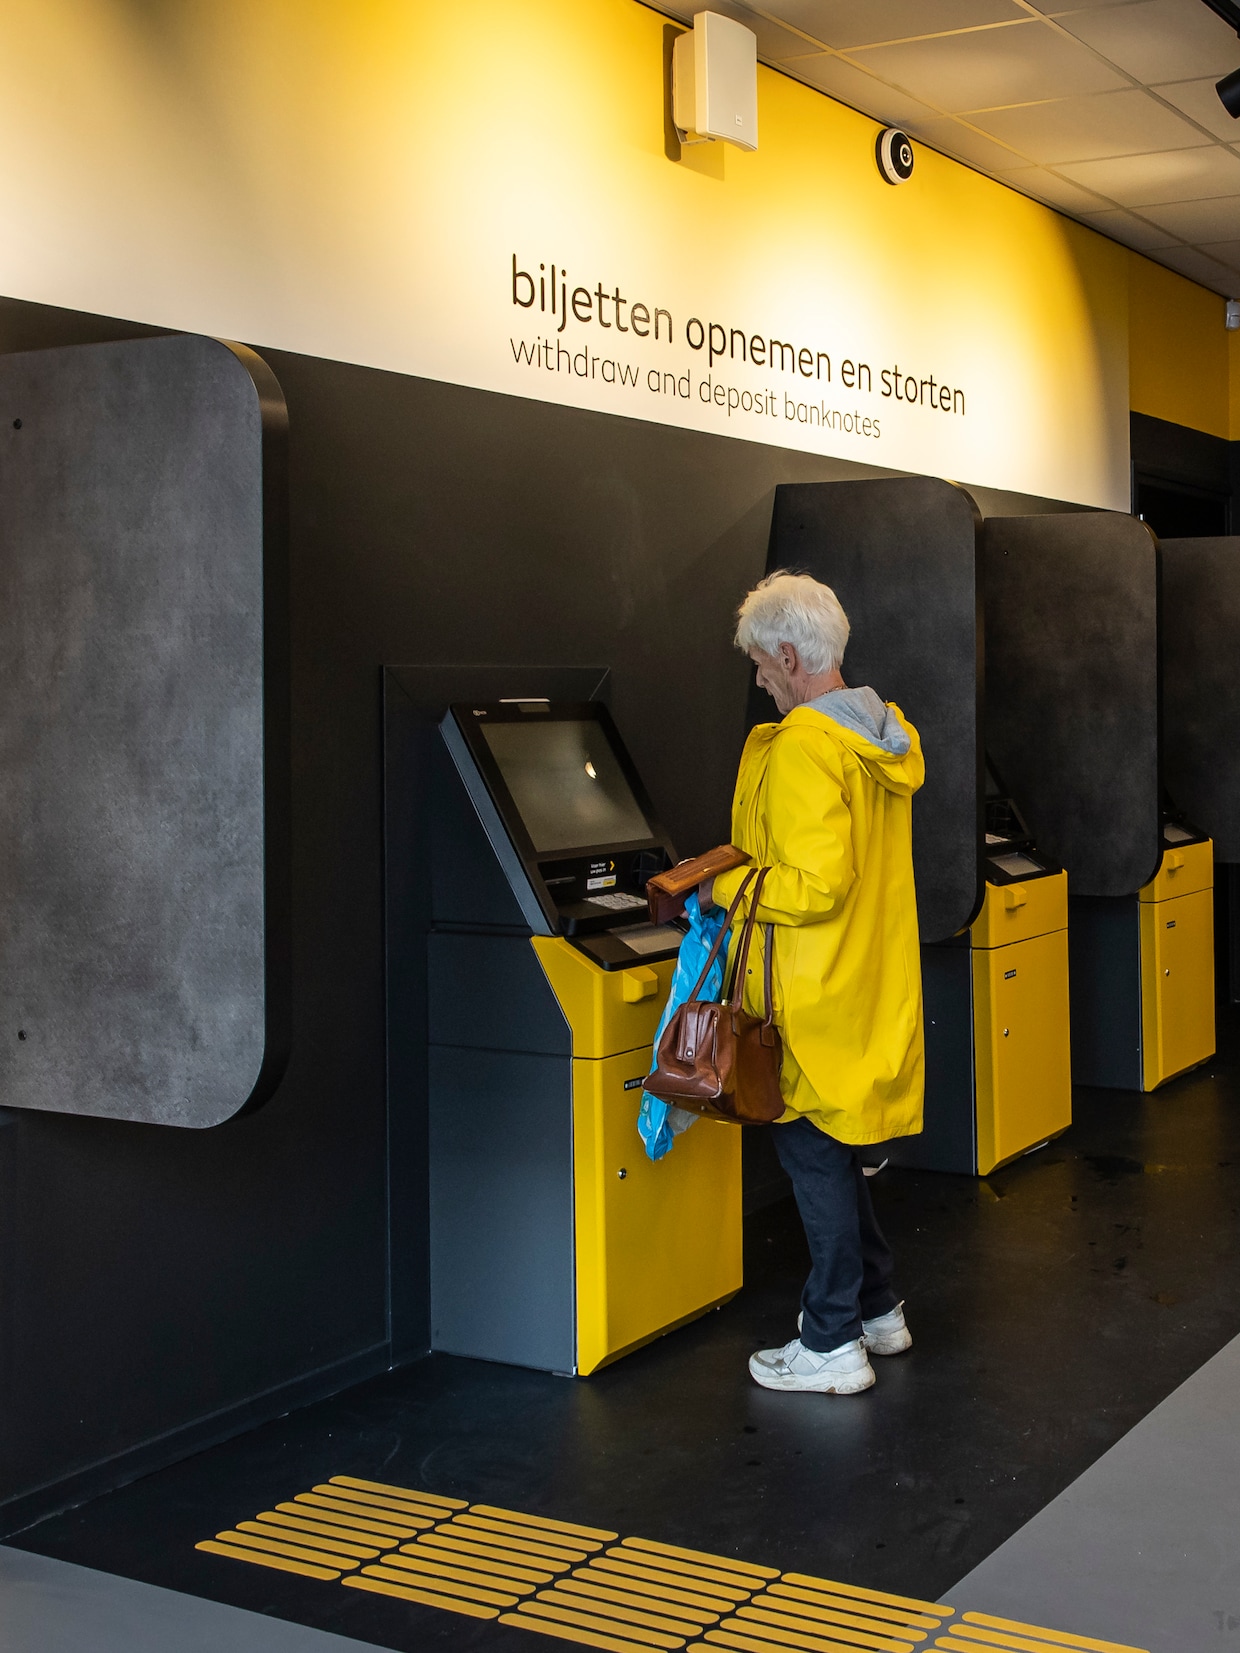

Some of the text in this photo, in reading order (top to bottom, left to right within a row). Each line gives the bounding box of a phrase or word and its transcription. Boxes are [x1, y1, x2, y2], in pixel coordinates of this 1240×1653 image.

[510, 337, 881, 438] withdraw and deposit banknotes
[511, 253, 966, 416] biljetten opnemen en storten
